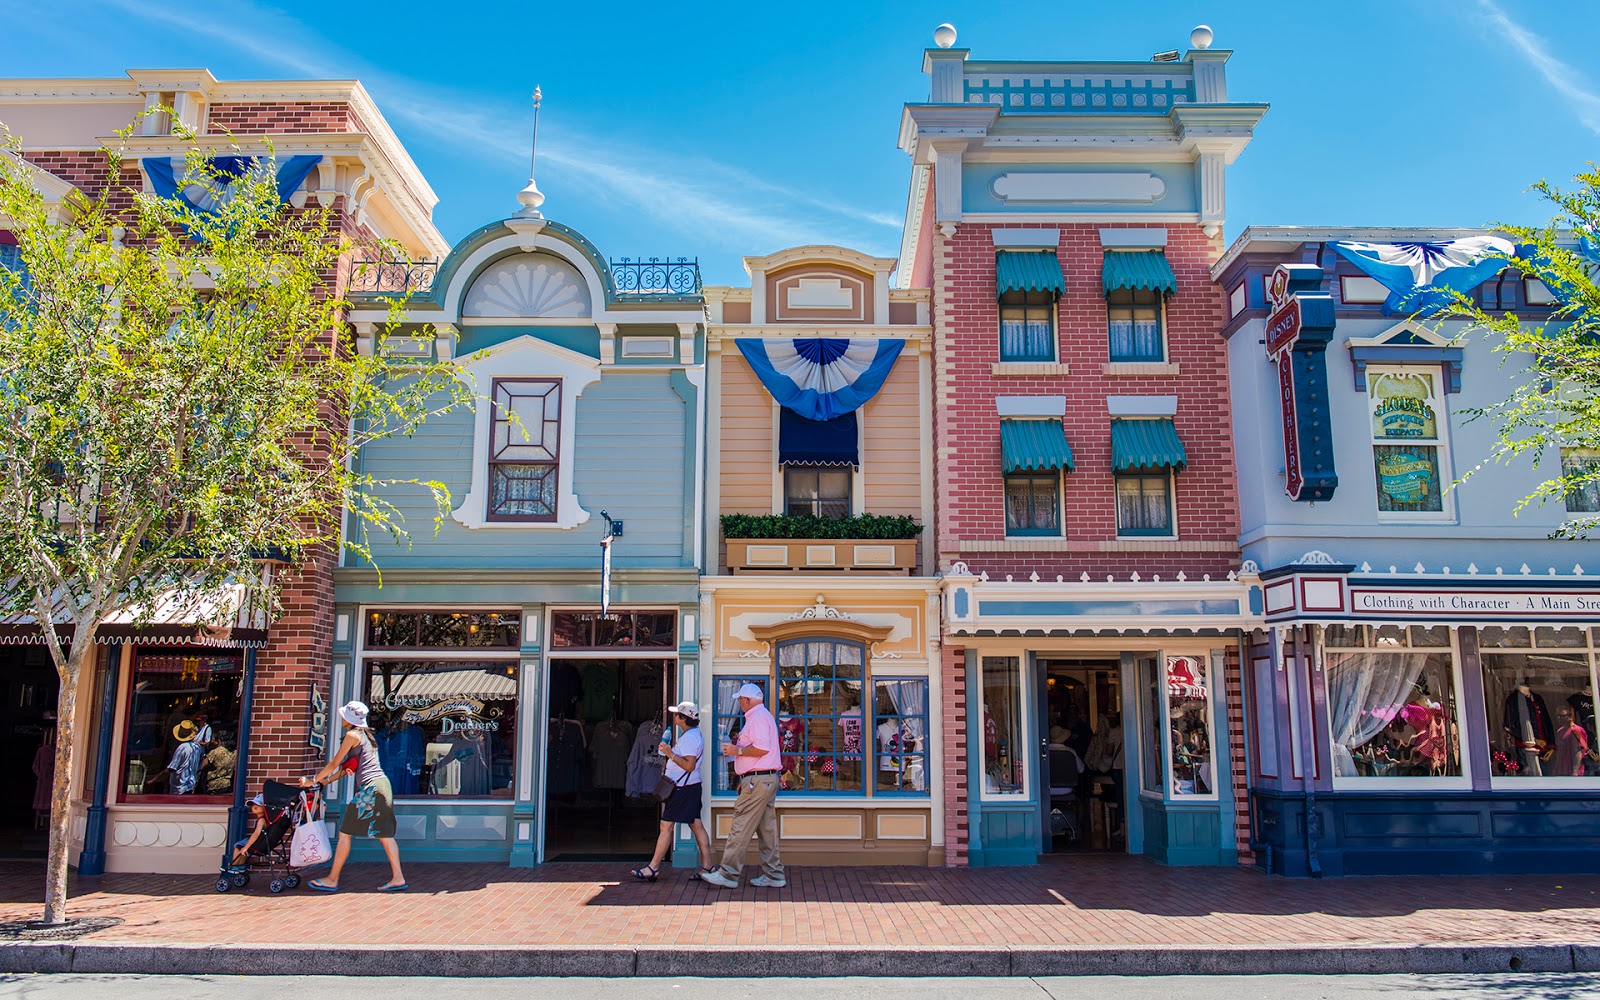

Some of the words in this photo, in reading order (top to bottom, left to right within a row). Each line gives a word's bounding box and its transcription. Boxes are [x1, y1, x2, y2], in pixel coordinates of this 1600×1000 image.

[1269, 312, 1296, 344] DISNEY
[1281, 359, 1297, 482] CLOTHIERS
[1363, 595, 1414, 610] Clothing
[1420, 596, 1445, 608] with
[1451, 596, 1510, 609] Character
[1526, 597, 1535, 609] A
[1541, 597, 1571, 609] Main
[385, 692, 431, 711] Chester
